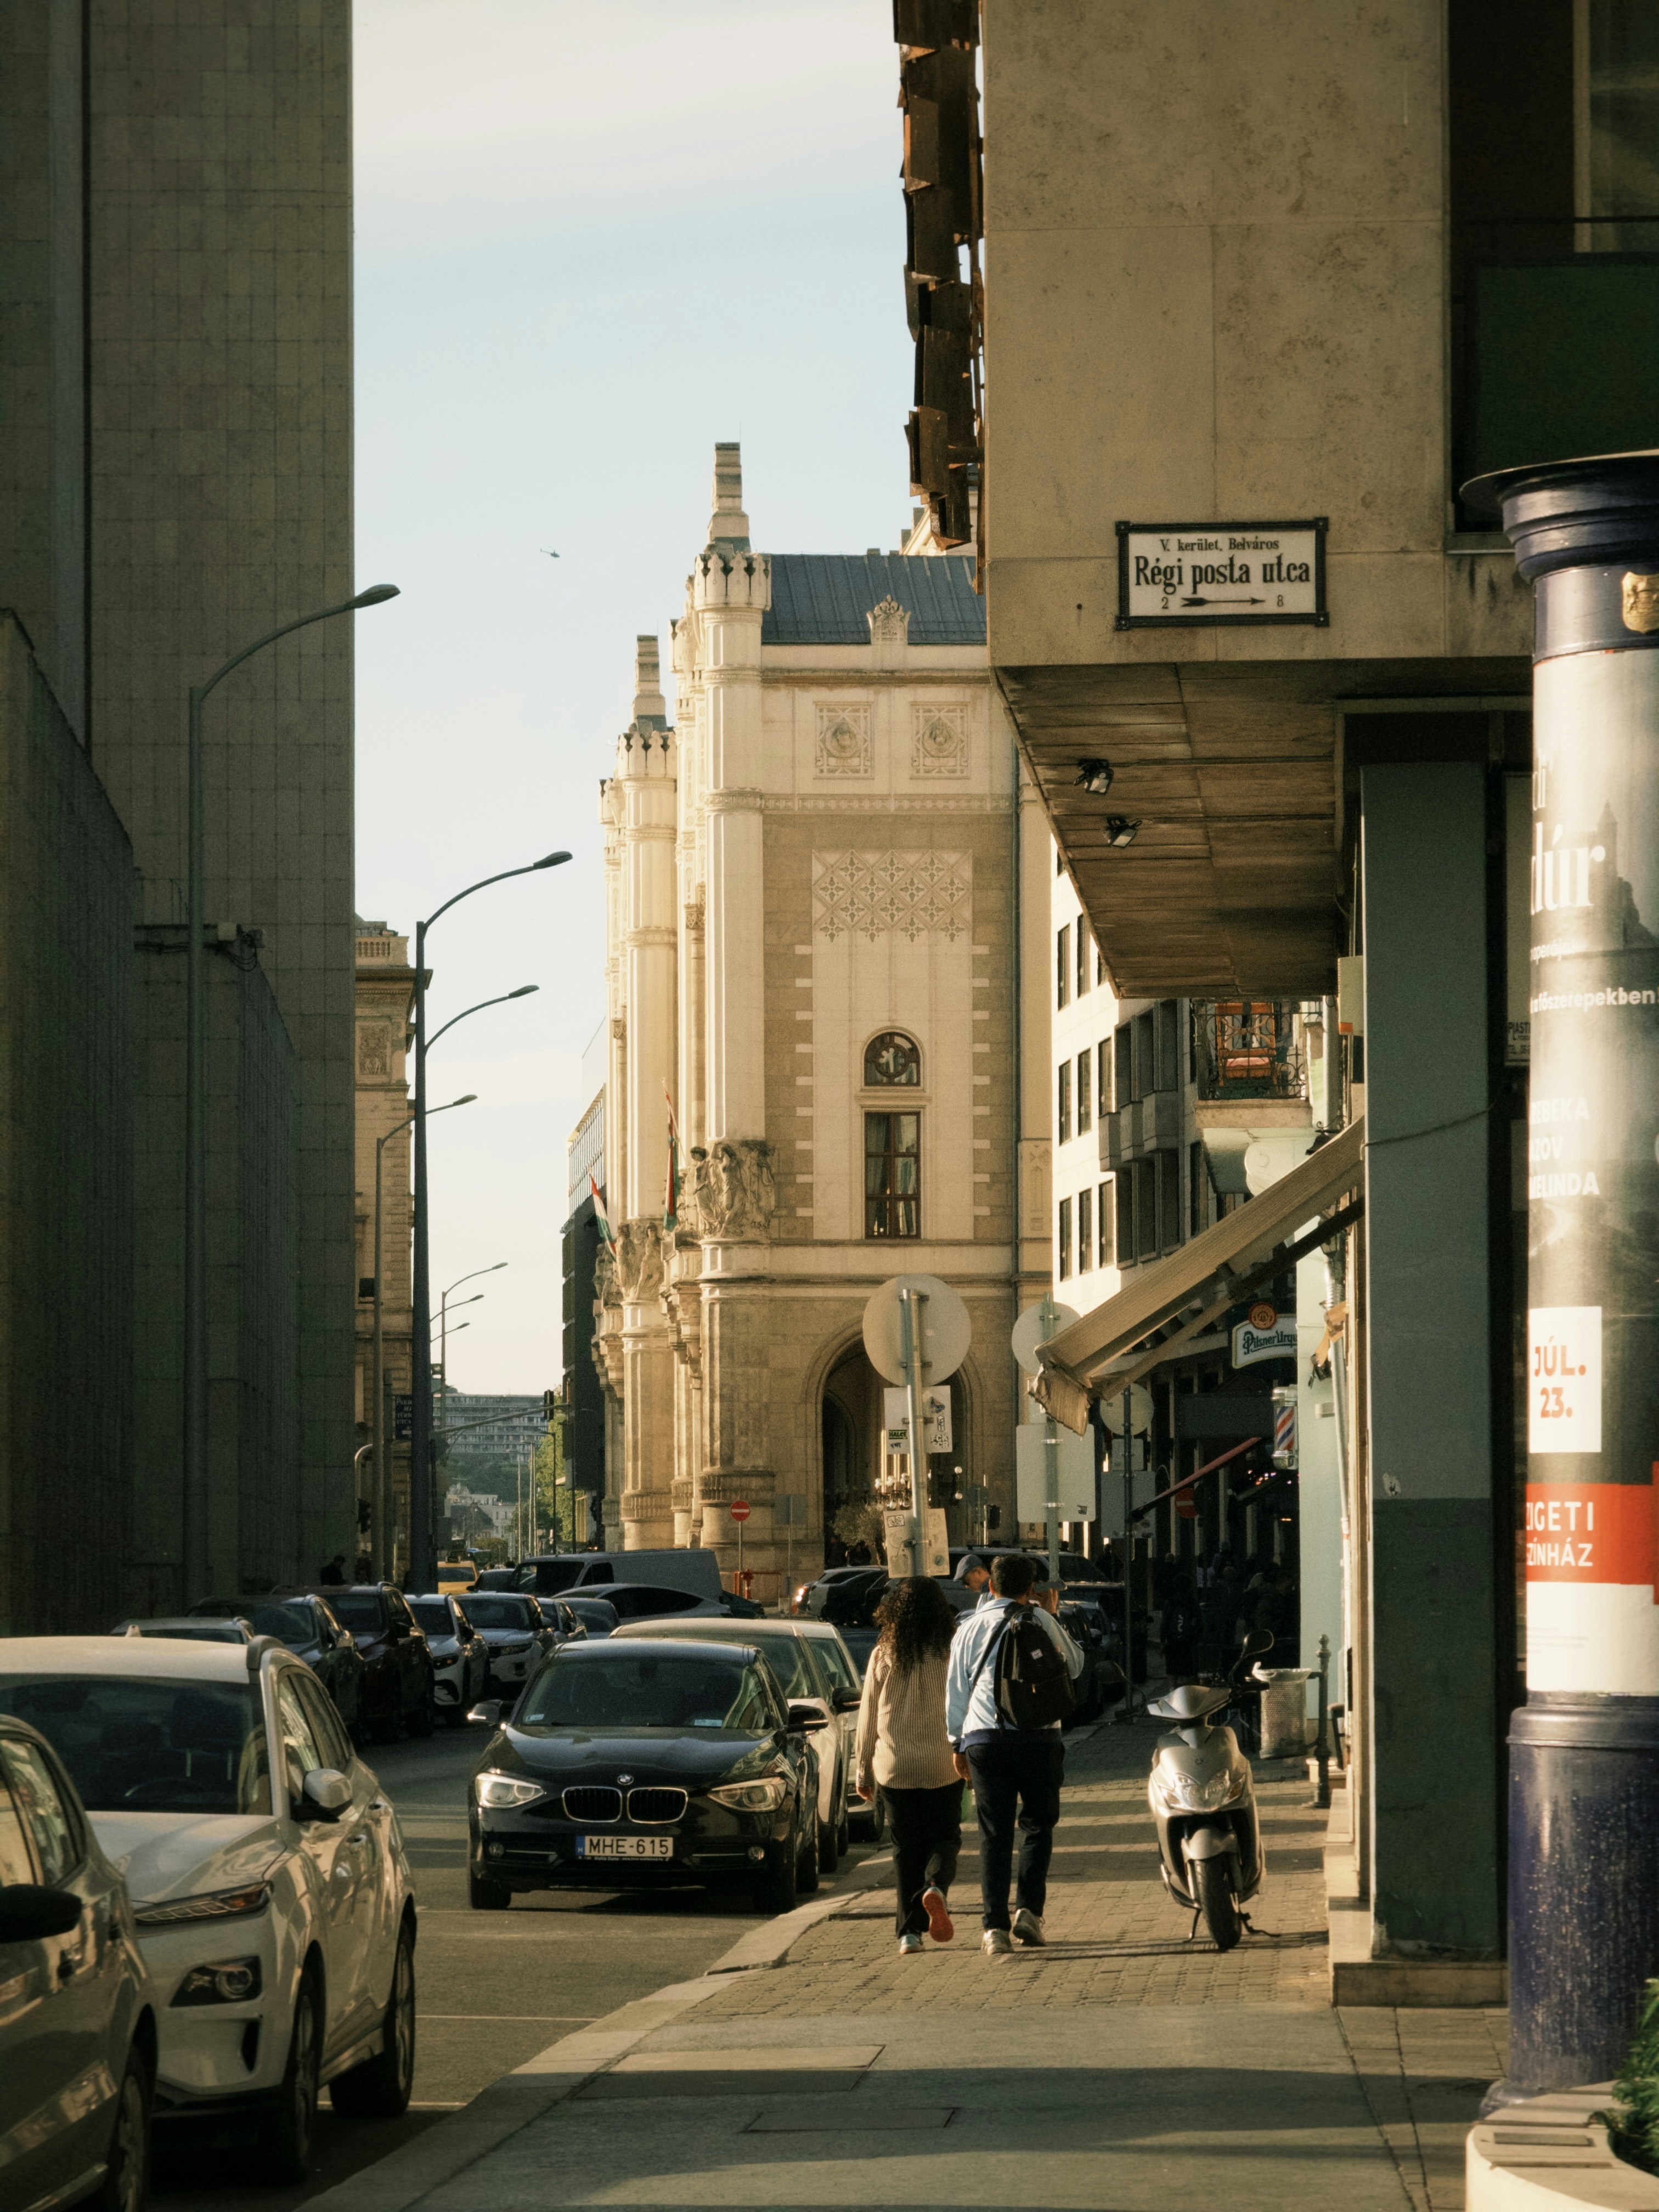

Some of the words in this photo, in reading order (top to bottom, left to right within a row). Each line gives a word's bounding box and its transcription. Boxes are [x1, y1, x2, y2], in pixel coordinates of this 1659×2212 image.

[1160, 539, 1170, 551] V.
[1178, 538, 1222, 551] kerület,
[1229, 536, 1279, 550] Belváros
[1135, 556, 1183, 595] Régi
[1191, 554, 1250, 595] posta
[1262, 553, 1311, 583] utca
[1161, 596, 1169, 609] 2
[1277, 595, 1284, 607] 8
[1243, 1330, 1277, 1355] Pilsner
[1534, 1335, 1587, 1377] JÚL.
[1541, 1386, 1573, 1418] 23.
[589, 1838, 669, 1855] MHE-615
